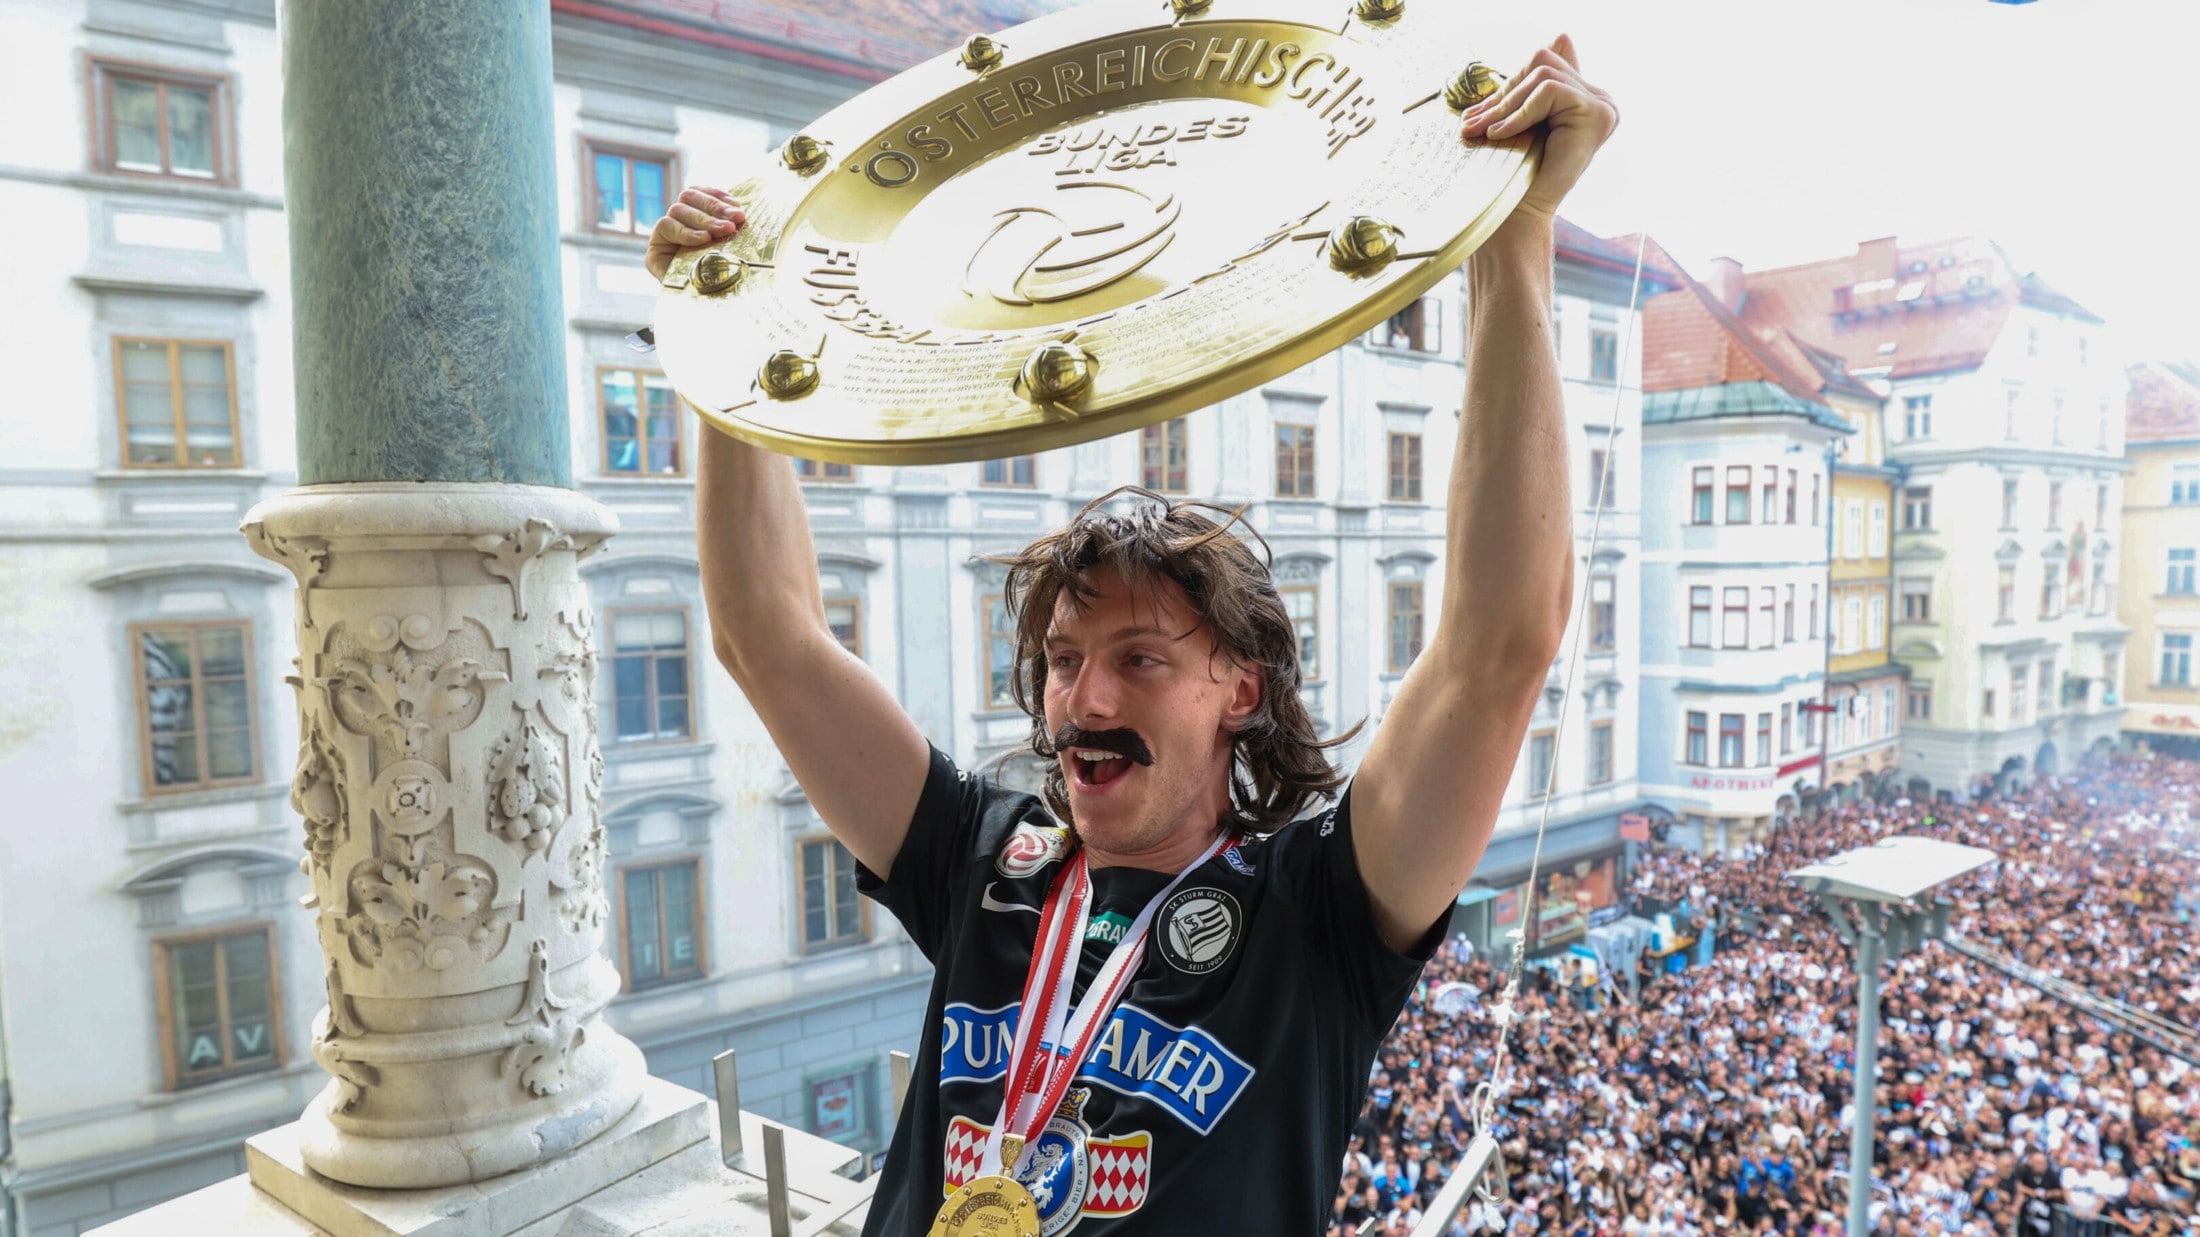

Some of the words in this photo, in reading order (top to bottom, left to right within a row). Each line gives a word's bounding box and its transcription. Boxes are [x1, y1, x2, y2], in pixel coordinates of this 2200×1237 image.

[1028, 116, 1250, 156] BUNDES
[1055, 148, 1177, 176] LIGA
[1169, 902, 1179, 911] SK
[1178, 891, 1204, 903] STURM
[1206, 891, 1227, 902] GRAZ
[1188, 963, 1205, 971] SEIT
[1072, 1179, 1084, 1205] BIER
